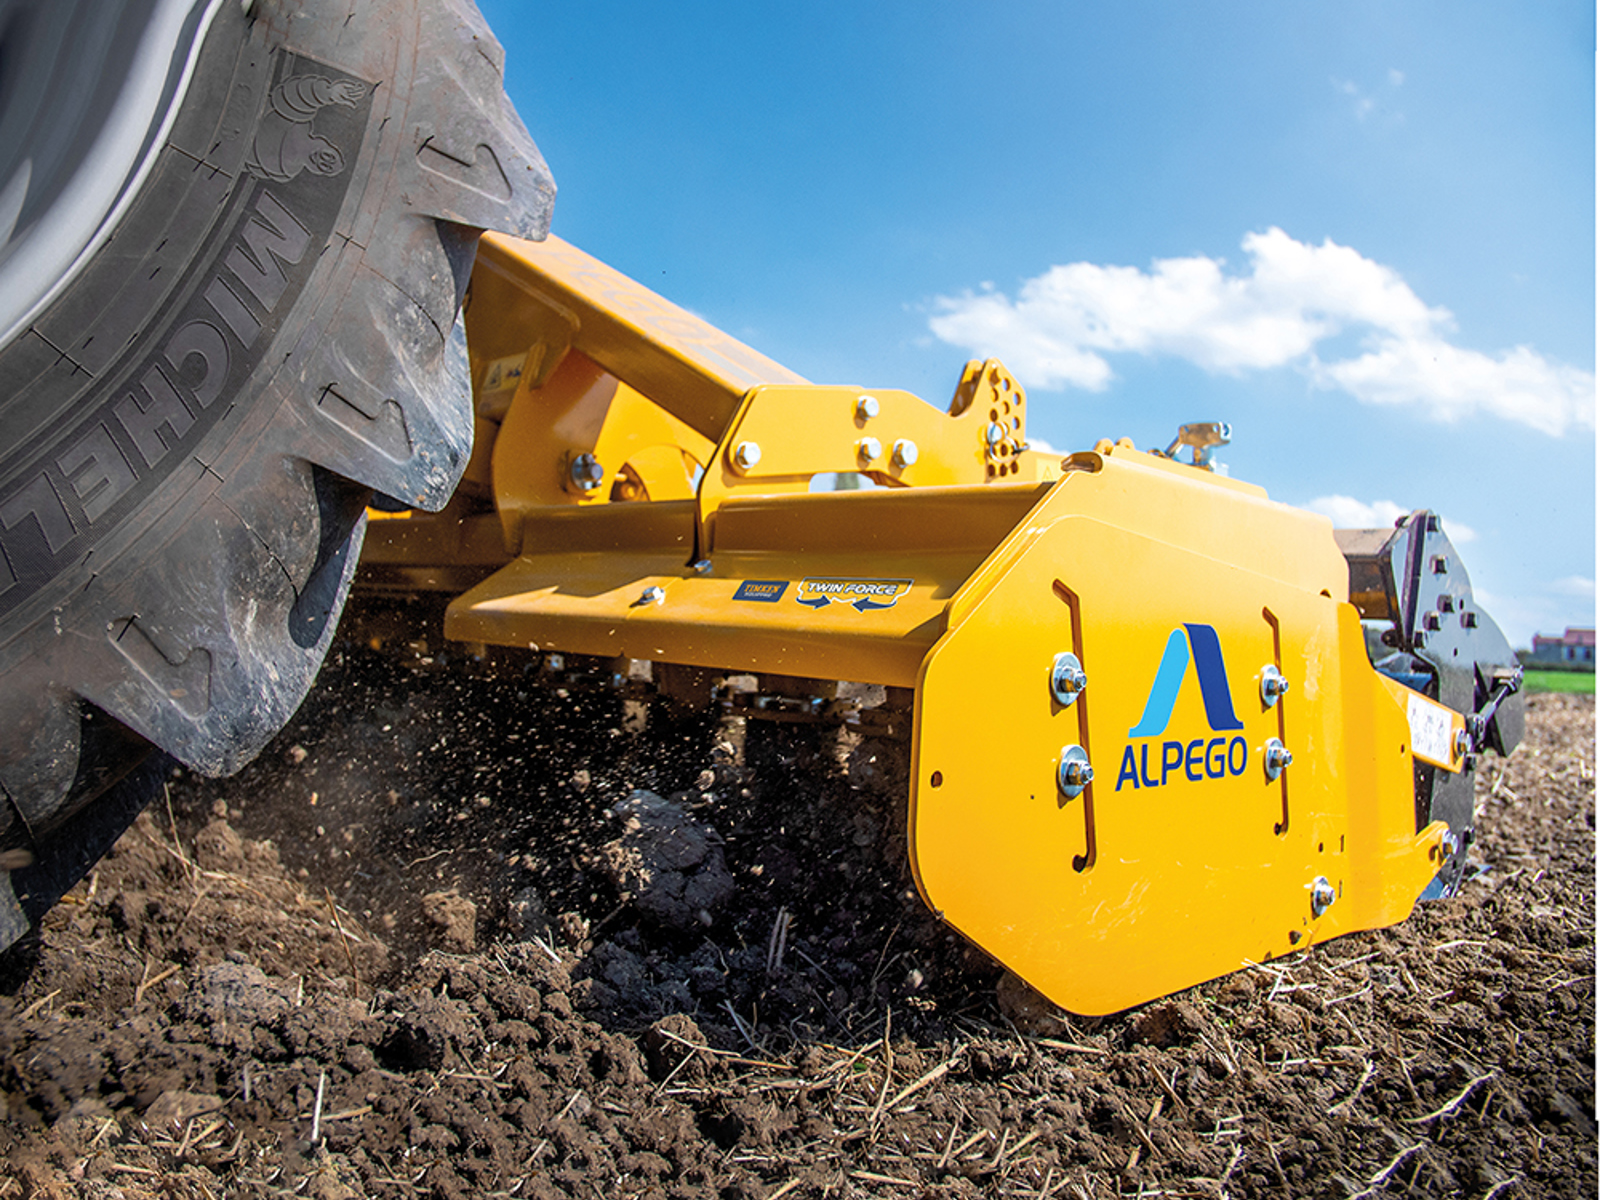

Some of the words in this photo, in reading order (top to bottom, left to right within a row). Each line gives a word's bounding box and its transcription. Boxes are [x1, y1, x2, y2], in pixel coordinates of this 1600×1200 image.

[0, 190, 313, 595] MICHEL
[808, 582, 842, 593] TWIN
[844, 583, 898, 596] FORCE
[1115, 736, 1248, 792] ALPEGO
